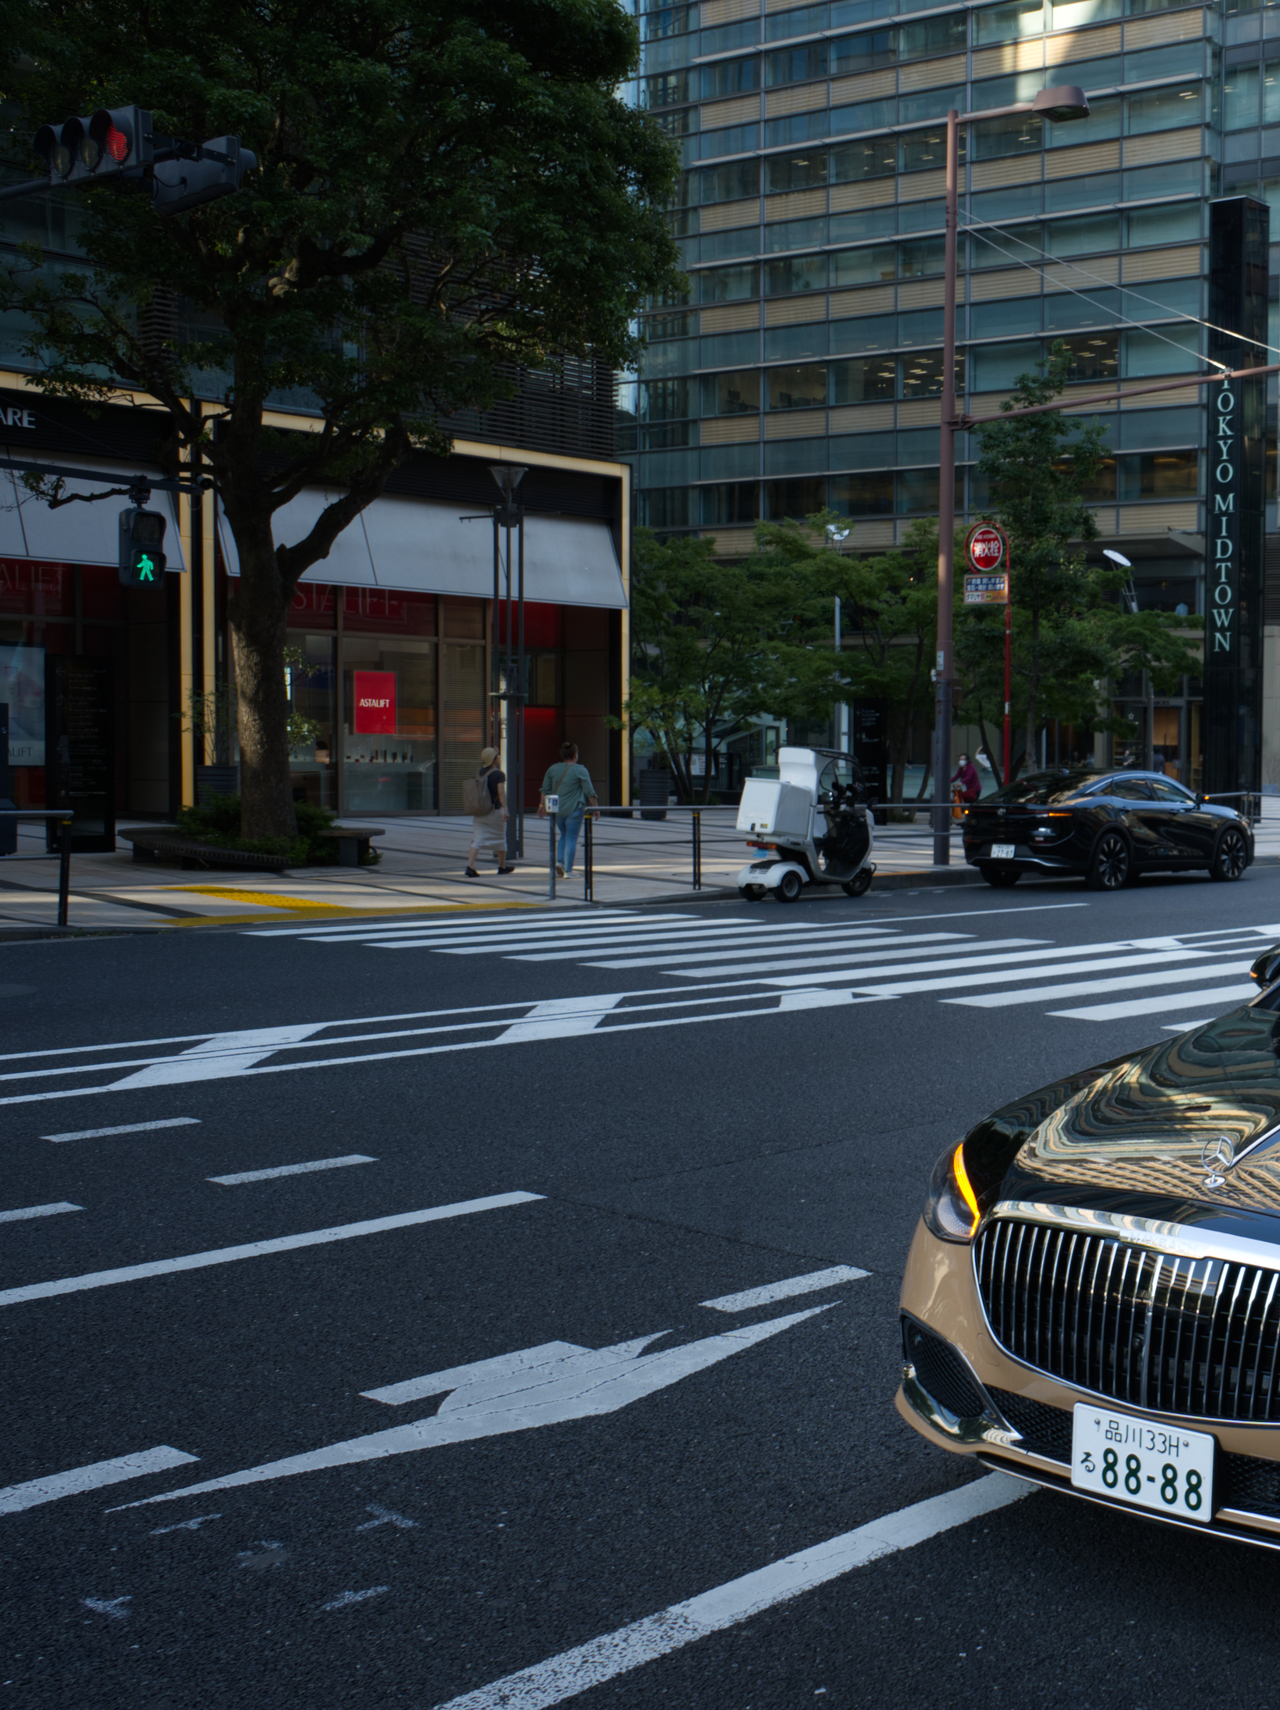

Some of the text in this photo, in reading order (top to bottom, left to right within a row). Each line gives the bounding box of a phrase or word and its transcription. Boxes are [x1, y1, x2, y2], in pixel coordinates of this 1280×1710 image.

[1211, 368, 1235, 652] TOKYO MIDTOWN
[974, 540, 999, 558] 消火栓
[359, 698, 390, 708] ASTALIFT
[1102, 1447, 1203, 1511] 88-88
